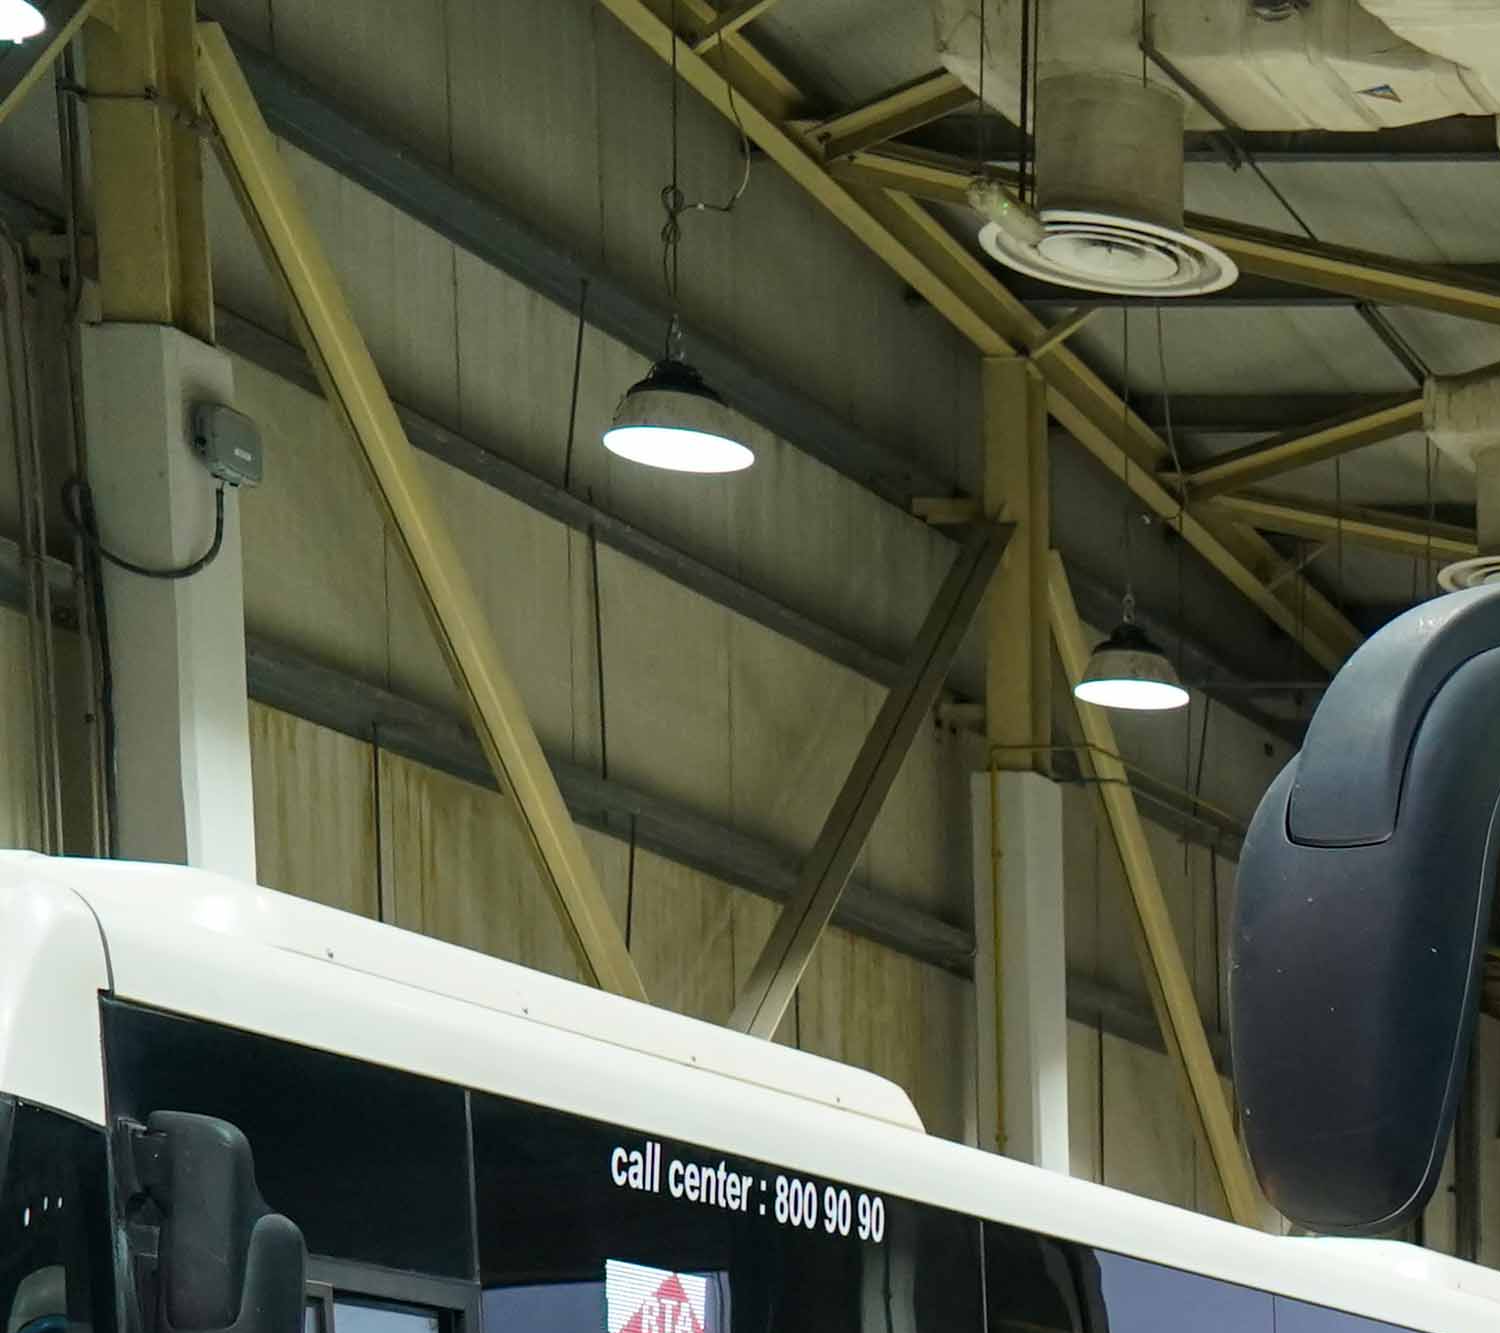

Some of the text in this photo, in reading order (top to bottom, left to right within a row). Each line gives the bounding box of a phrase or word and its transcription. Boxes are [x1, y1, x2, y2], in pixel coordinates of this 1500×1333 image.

[611, 1141, 661, 1192] call
[668, 1160, 753, 1212] center
[774, 1175, 818, 1229] 800
[823, 1186, 851, 1236] 90
[857, 1193, 885, 1243] 90
